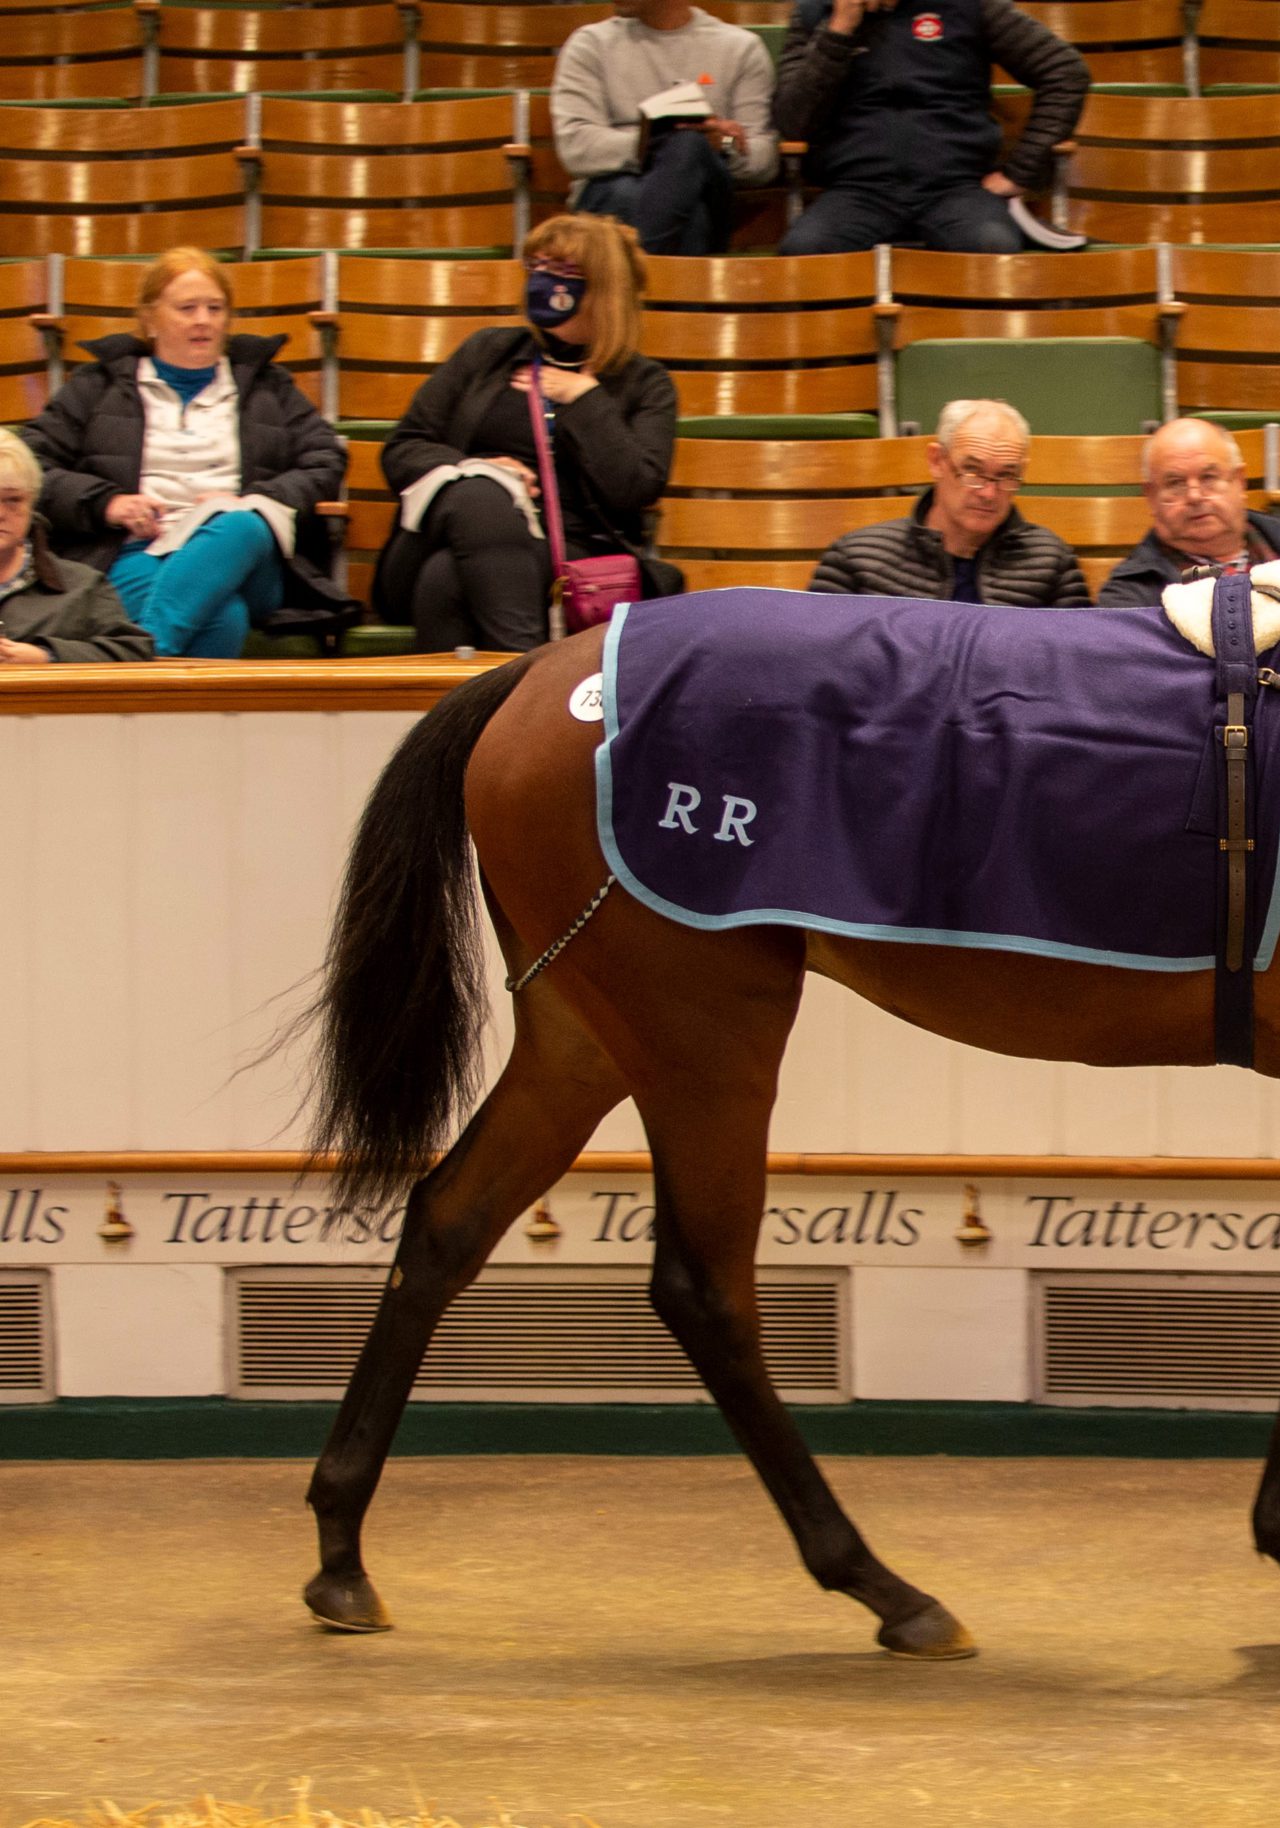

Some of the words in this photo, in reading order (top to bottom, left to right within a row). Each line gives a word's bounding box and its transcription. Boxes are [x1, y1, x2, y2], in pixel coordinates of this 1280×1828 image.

[580, 690, 603, 707] 73
[658, 782, 702, 835] R
[713, 794, 757, 847] R
